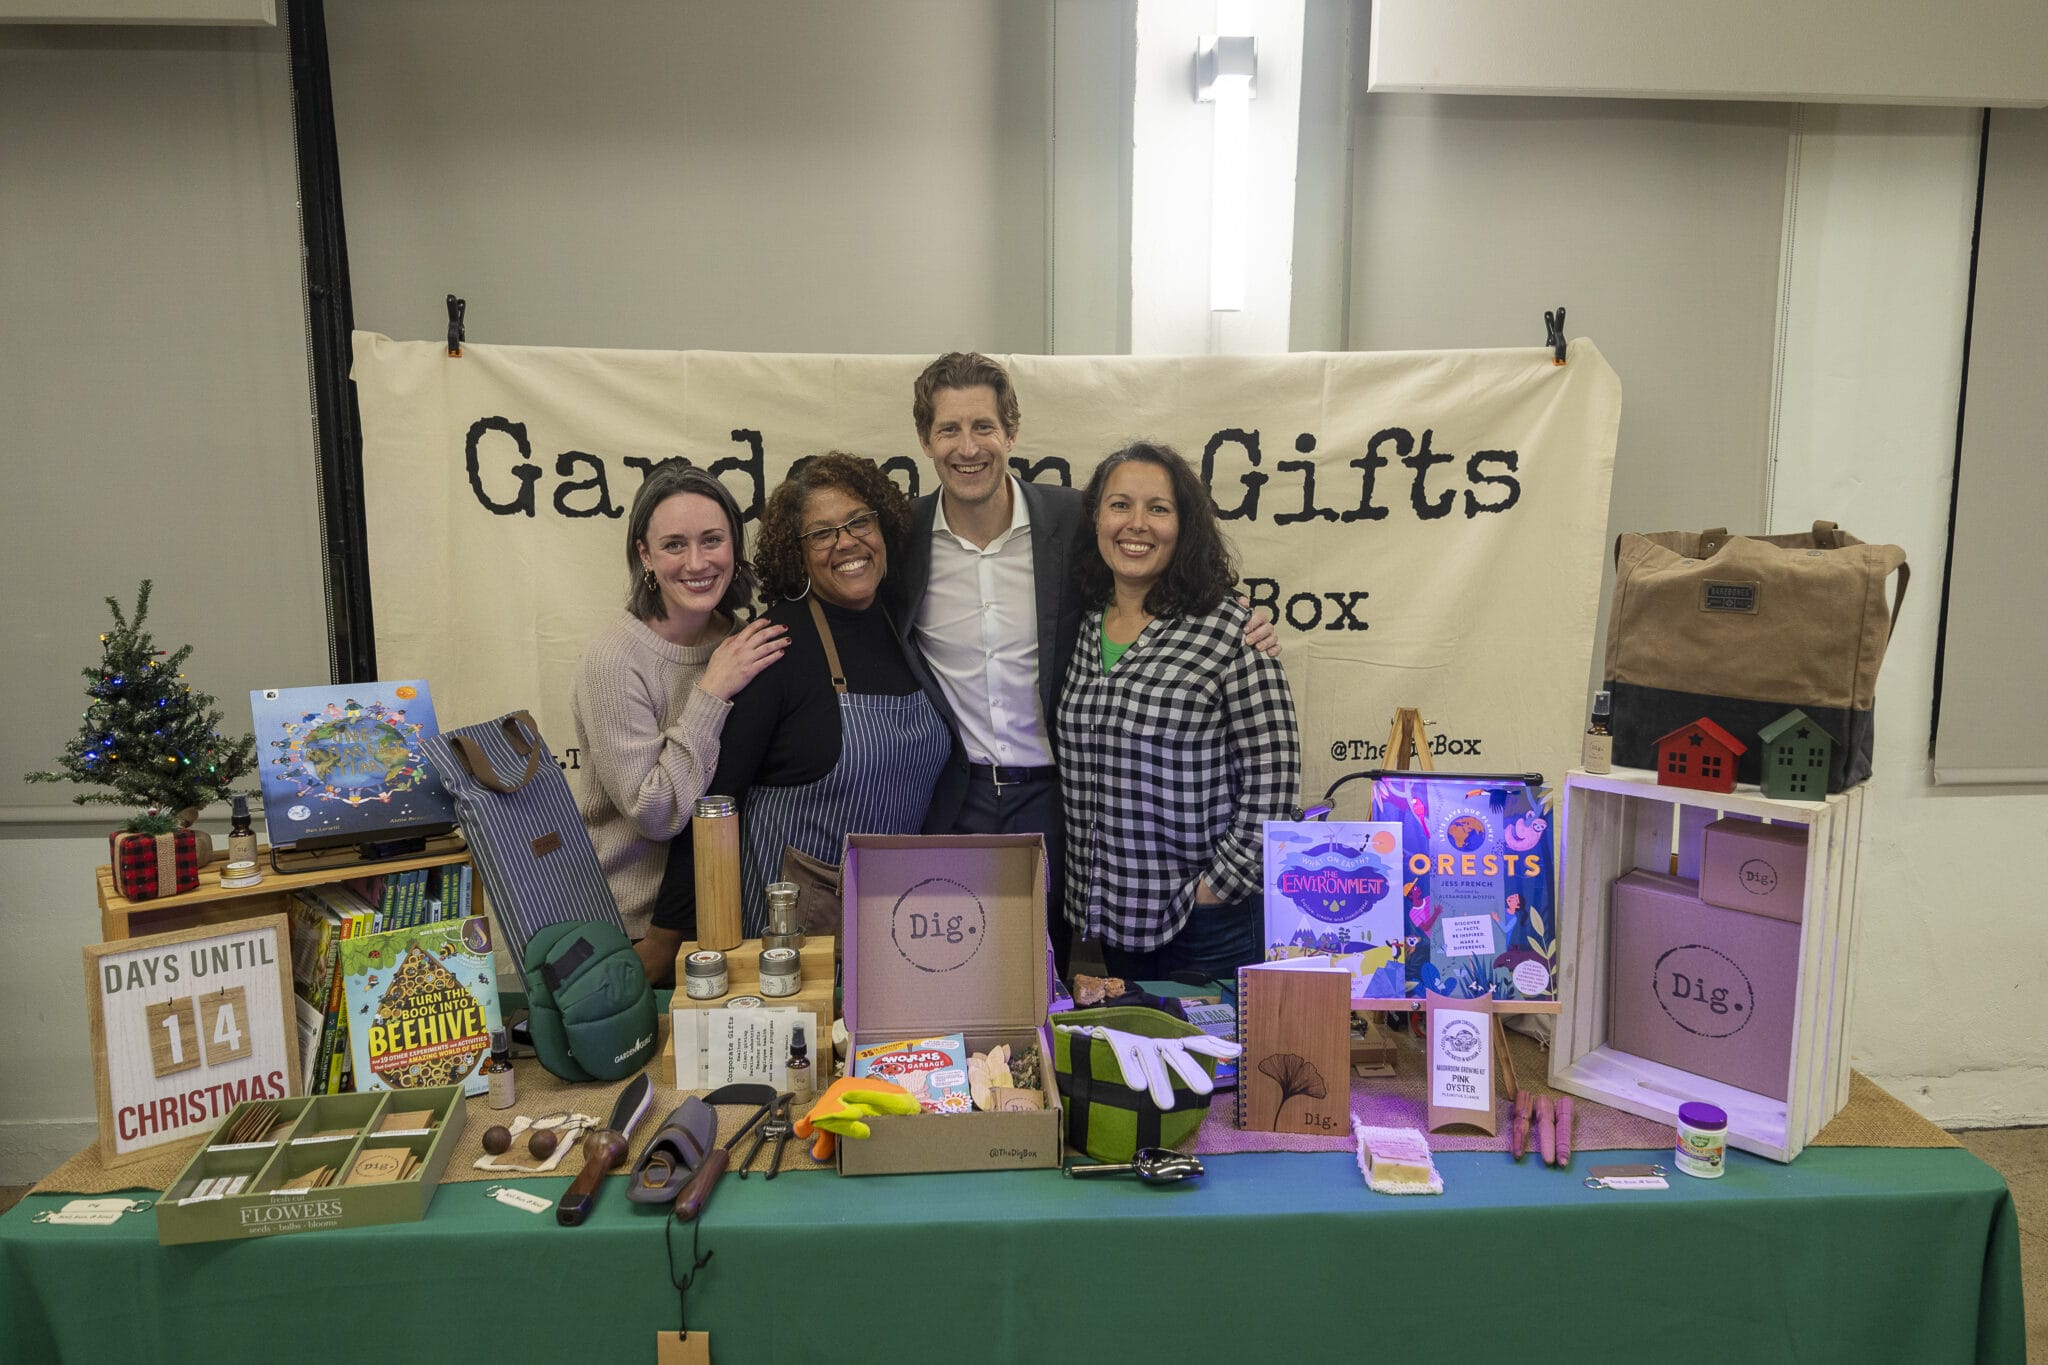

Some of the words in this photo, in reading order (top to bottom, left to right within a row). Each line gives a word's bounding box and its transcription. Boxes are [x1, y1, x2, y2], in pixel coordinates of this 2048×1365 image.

[1201, 427, 1521, 525] Gifts
[1243, 578, 1369, 631] Box
[1464, 808, 1481, 816] OUR
[1302, 856, 1323, 867] WHAT
[1341, 856, 1370, 868] EARTH?
[1409, 853, 1541, 877] ORESTS
[1323, 870, 1338, 878] THE
[1746, 872, 1774, 885] Dig.
[1283, 874, 1384, 895] ENVIRONMENT
[909, 912, 977, 944] Dig.
[104, 954, 179, 994] DAYS
[192, 937, 274, 978] UNTIL
[408, 993, 441, 1007] TURN
[444, 987, 471, 1001] THIS
[1672, 972, 1743, 1015] Dig.
[402, 1005, 437, 1019] BOOK
[439, 999, 468, 1013] INTO
[471, 996, 479, 1006] A
[369, 1005, 488, 1057] BEEHIVE!
[389, 1053, 408, 1061] OTHER
[409, 1044, 449, 1057] EXPERIMENTS
[458, 1037, 488, 1047] ACTIVITIES
[408, 1054, 438, 1064] AMAZING
[438, 1050, 461, 1059] WORLD
[462, 1046, 470, 1054] OF
[471, 1042, 487, 1050] BEES
[882, 1052, 941, 1064] WORMS
[907, 1060, 945, 1069] GARBAGE
[1437, 1064, 1460, 1073] MUSHROOM
[1461, 1066, 1479, 1075] GROWING
[1446, 1083, 1475, 1093] OYSTER
[1452, 1075, 1470, 1083] PINK
[117, 1070, 286, 1141] CHRISTMAS
[1304, 1113, 1338, 1129] Dig.
[989, 1148, 1037, 1159] @TheDigBox
[270, 1196, 288, 1204] fresh
[240, 1201, 343, 1224] FLOWERS
[249, 1224, 271, 1234] seeds
[279, 1222, 301, 1232] bulbs
[308, 1219, 338, 1230] blooms
